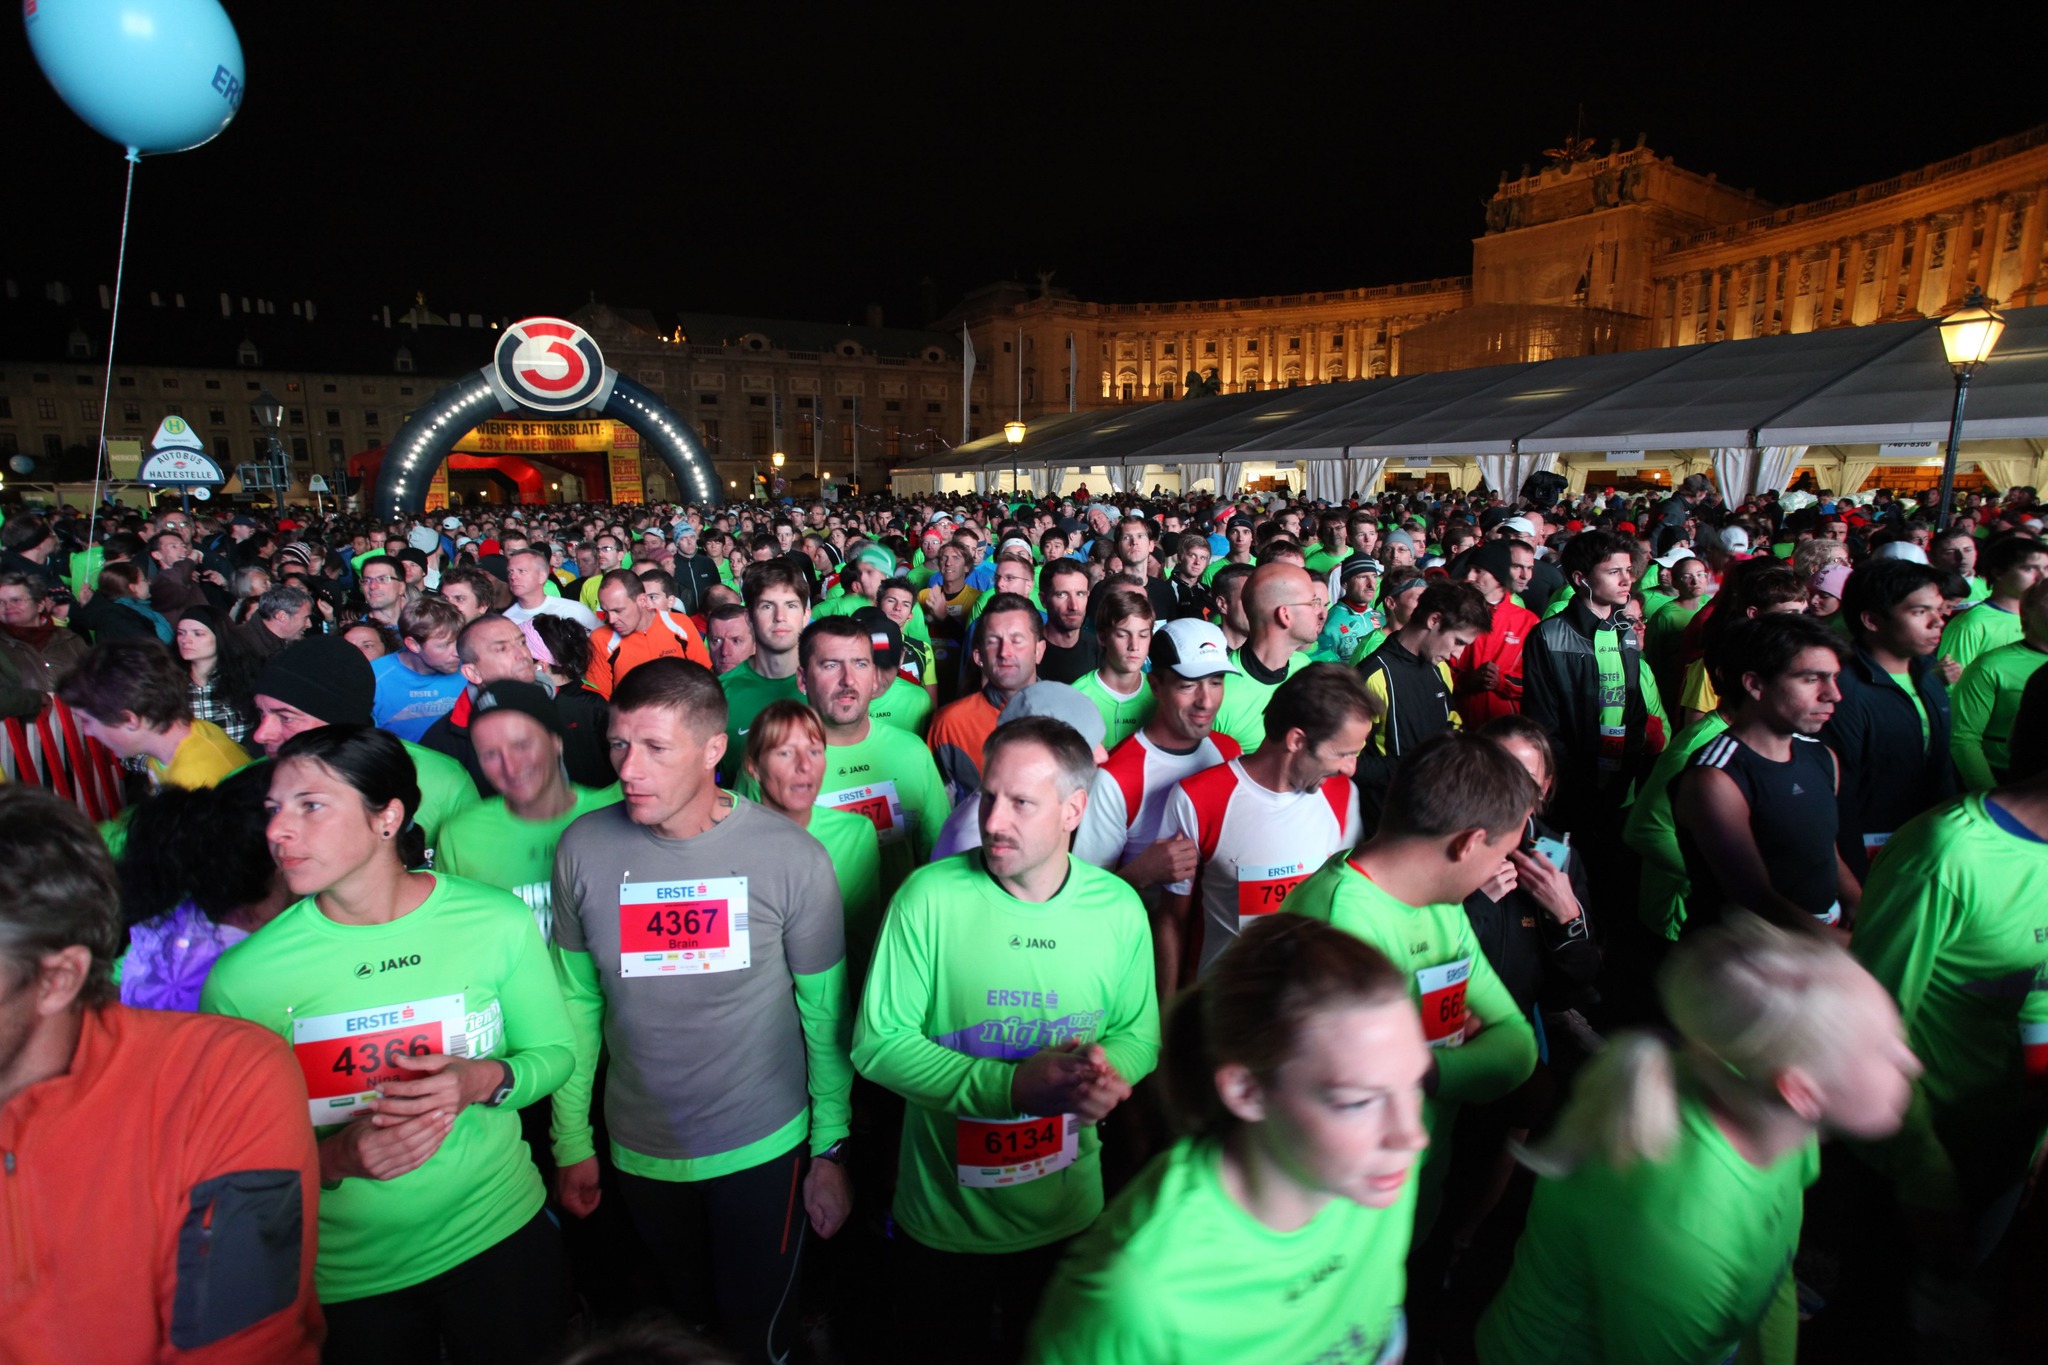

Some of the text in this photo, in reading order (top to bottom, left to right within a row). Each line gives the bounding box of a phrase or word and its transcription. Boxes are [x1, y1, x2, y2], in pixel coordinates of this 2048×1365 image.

[476, 422, 604, 435] WIENER BEZIRKSBLATT:
[479, 438, 579, 450] 23x MITTEN DRIN.
[157, 451, 203, 465] AUTOBUS
[149, 470, 212, 479] HALTESTELLE
[409, 690, 432, 698] ERSTE
[849, 764, 870, 774] JAKO
[838, 789, 865, 803] ERSTE
[1268, 864, 1296, 877] ERSTE
[657, 886, 695, 899] ERSTE
[1260, 882, 1298, 905] 79
[646, 908, 719, 936] 4367
[668, 938, 699, 949] Brain
[1025, 938, 1057, 950] JAKO
[379, 954, 422, 973] JAKO
[986, 989, 1043, 1008] ERSTE
[346, 1010, 399, 1032] ERSTE
[984, 1122, 1056, 1155] 6134
